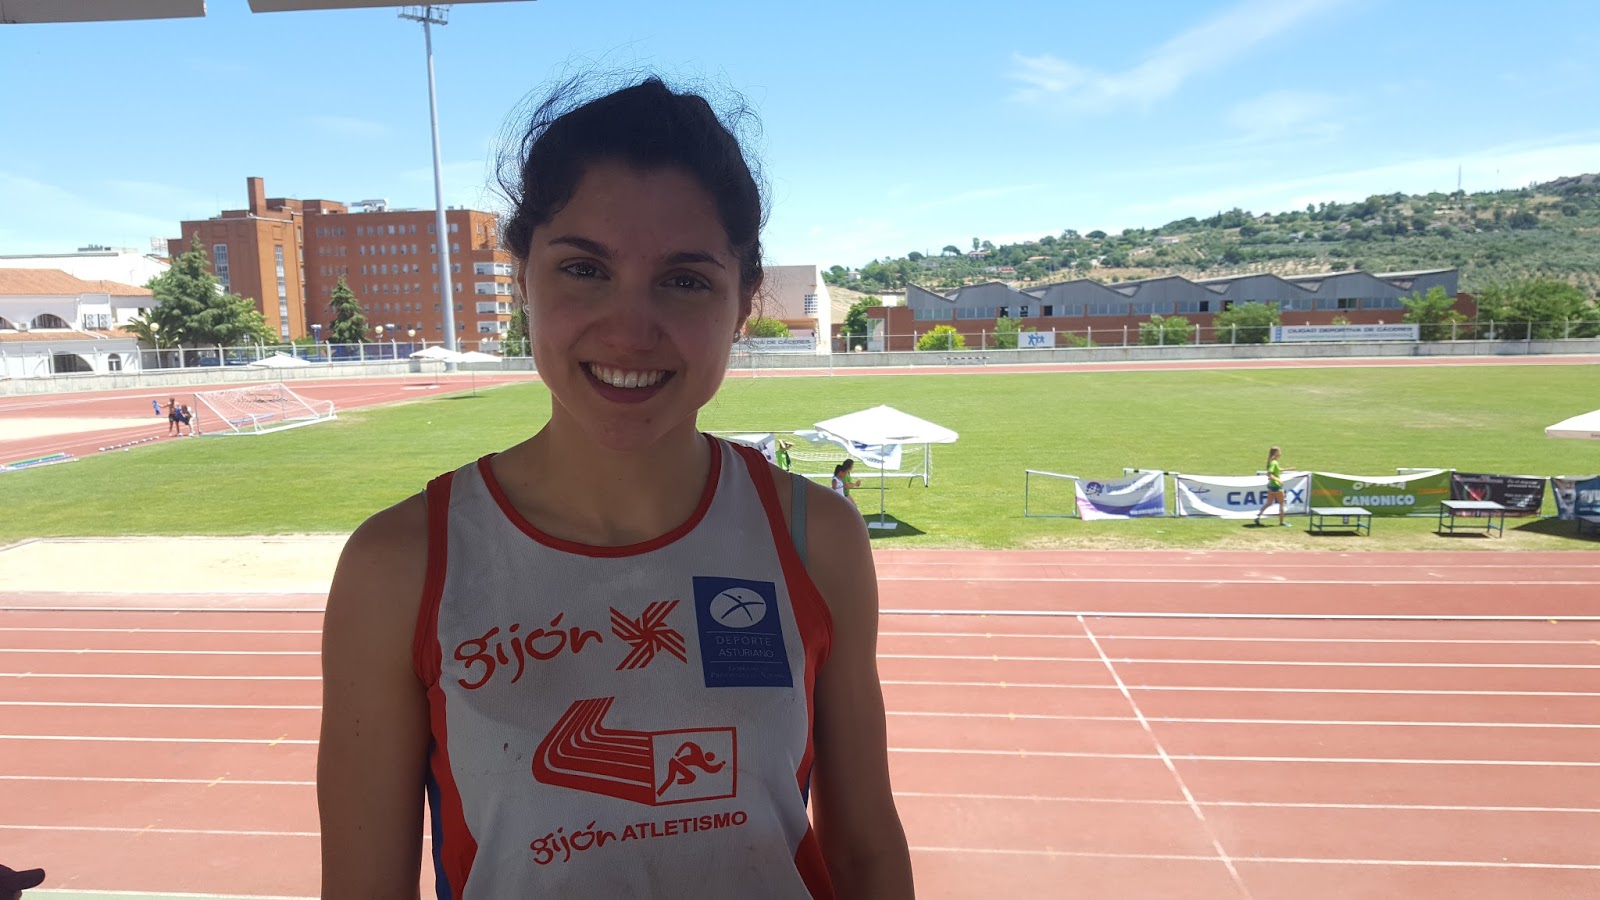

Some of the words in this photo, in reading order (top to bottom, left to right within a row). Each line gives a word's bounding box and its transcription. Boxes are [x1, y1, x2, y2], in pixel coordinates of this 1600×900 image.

[716, 635, 772, 647] DEPORTE
[718, 648, 775, 658] ASTURIANO
[621, 810, 748, 841] ATLETISMO
